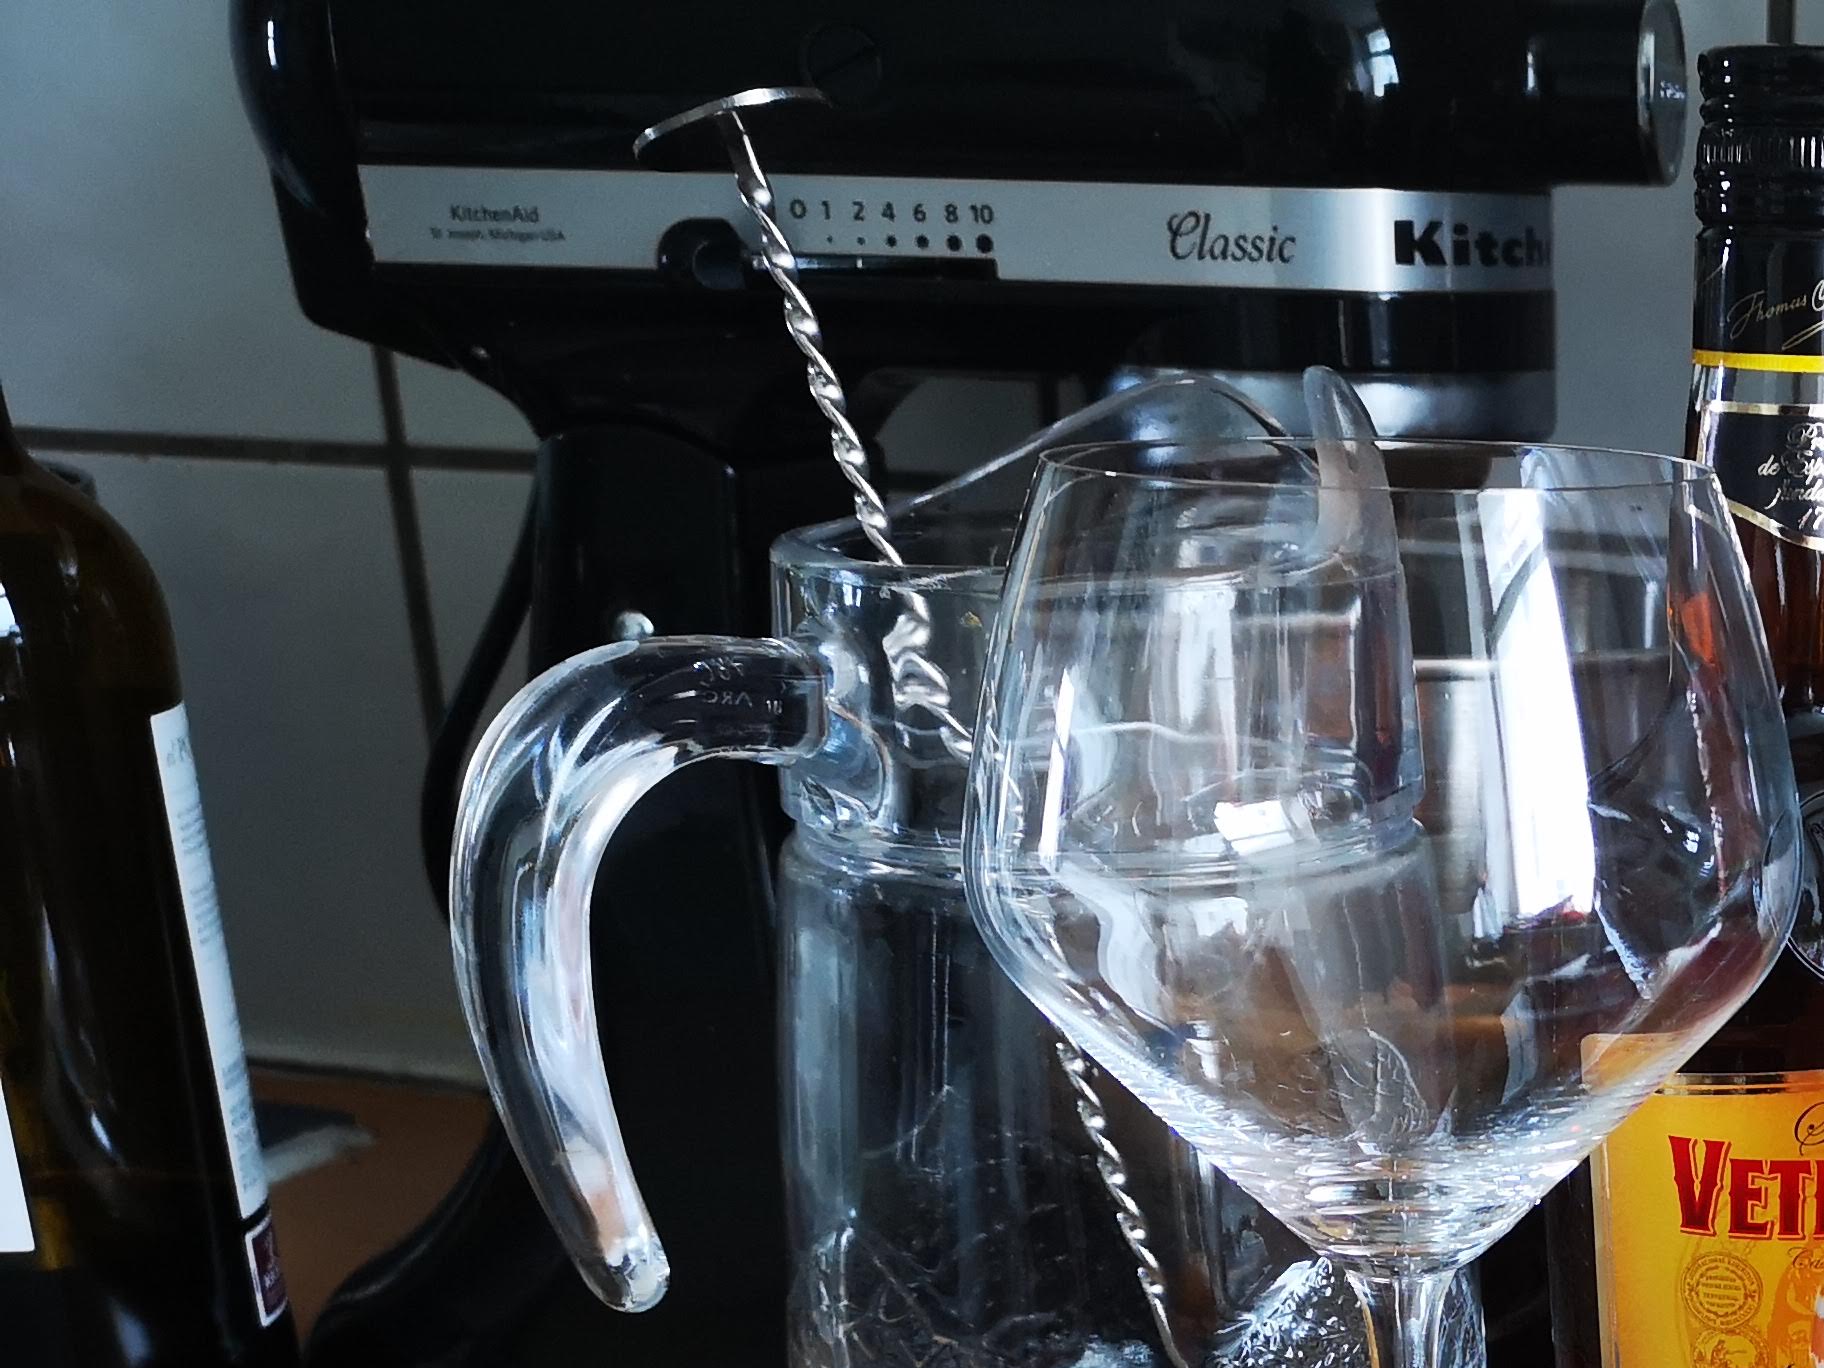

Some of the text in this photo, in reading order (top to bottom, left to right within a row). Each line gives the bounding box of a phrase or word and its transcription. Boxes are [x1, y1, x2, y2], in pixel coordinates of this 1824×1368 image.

[790, 199, 994, 225] 0 1 2 4 6 8 10
[1167, 210, 1296, 264] Classic
[1758, 454, 1780, 476] de
